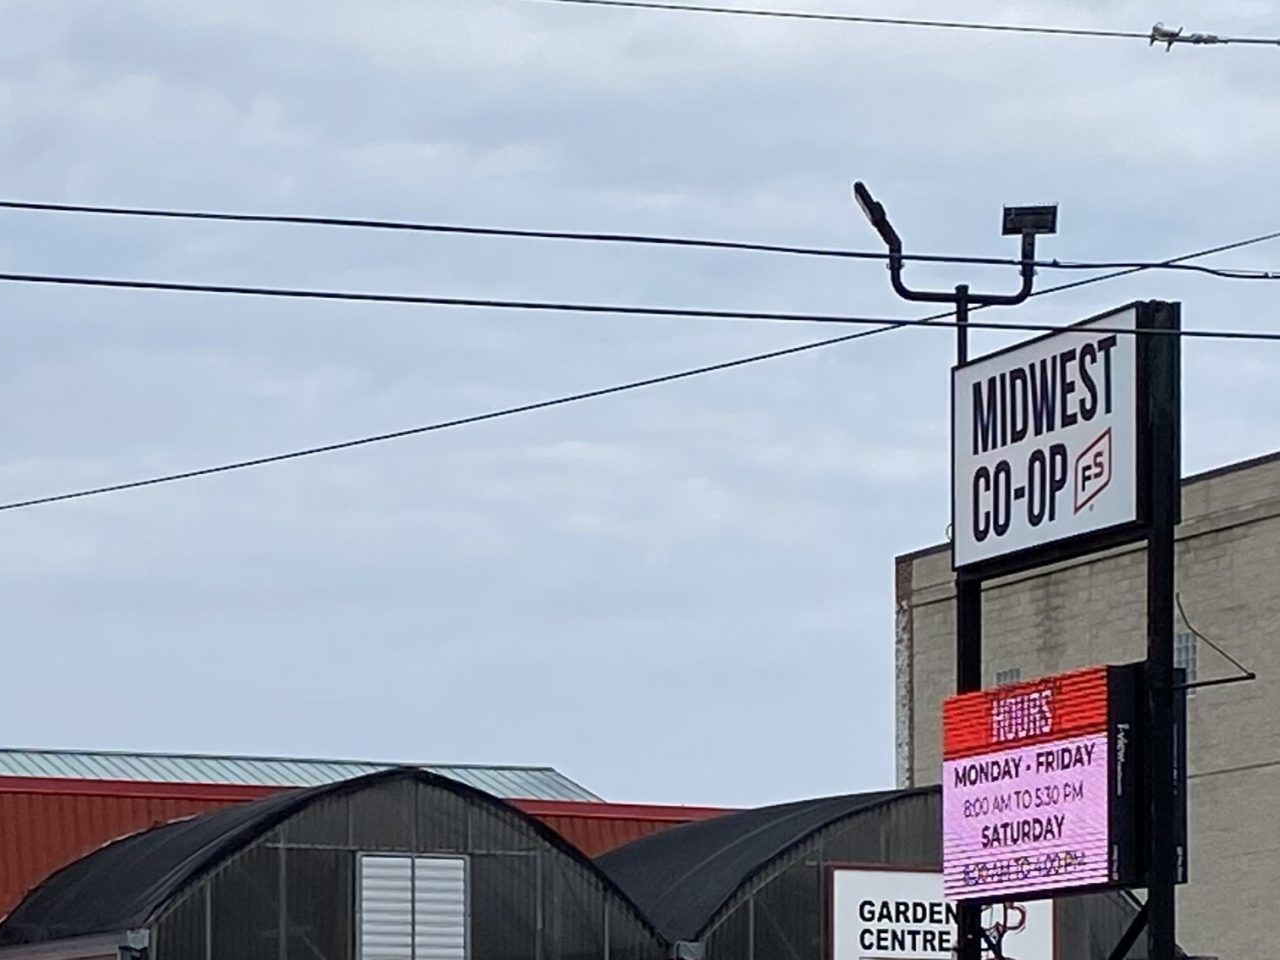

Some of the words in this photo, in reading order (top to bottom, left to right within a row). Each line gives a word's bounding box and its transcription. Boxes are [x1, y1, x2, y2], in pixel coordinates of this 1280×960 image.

[972, 334, 1117, 455] MIDWEST
[1081, 451, 1104, 492] FS
[972, 443, 1068, 542] CO-OP
[991, 689, 1053, 743] HOURS
[954, 755, 1022, 788] MONDAY
[1035, 742, 1095, 774] FRIDAY
[991, 793, 1012, 813] AM
[1014, 789, 1032, 809] TO
[1063, 779, 1084, 803] PM
[981, 813, 1066, 849] SATURDAY
[858, 900, 958, 925] GARDEN
[859, 929, 951, 952] CENTRE
